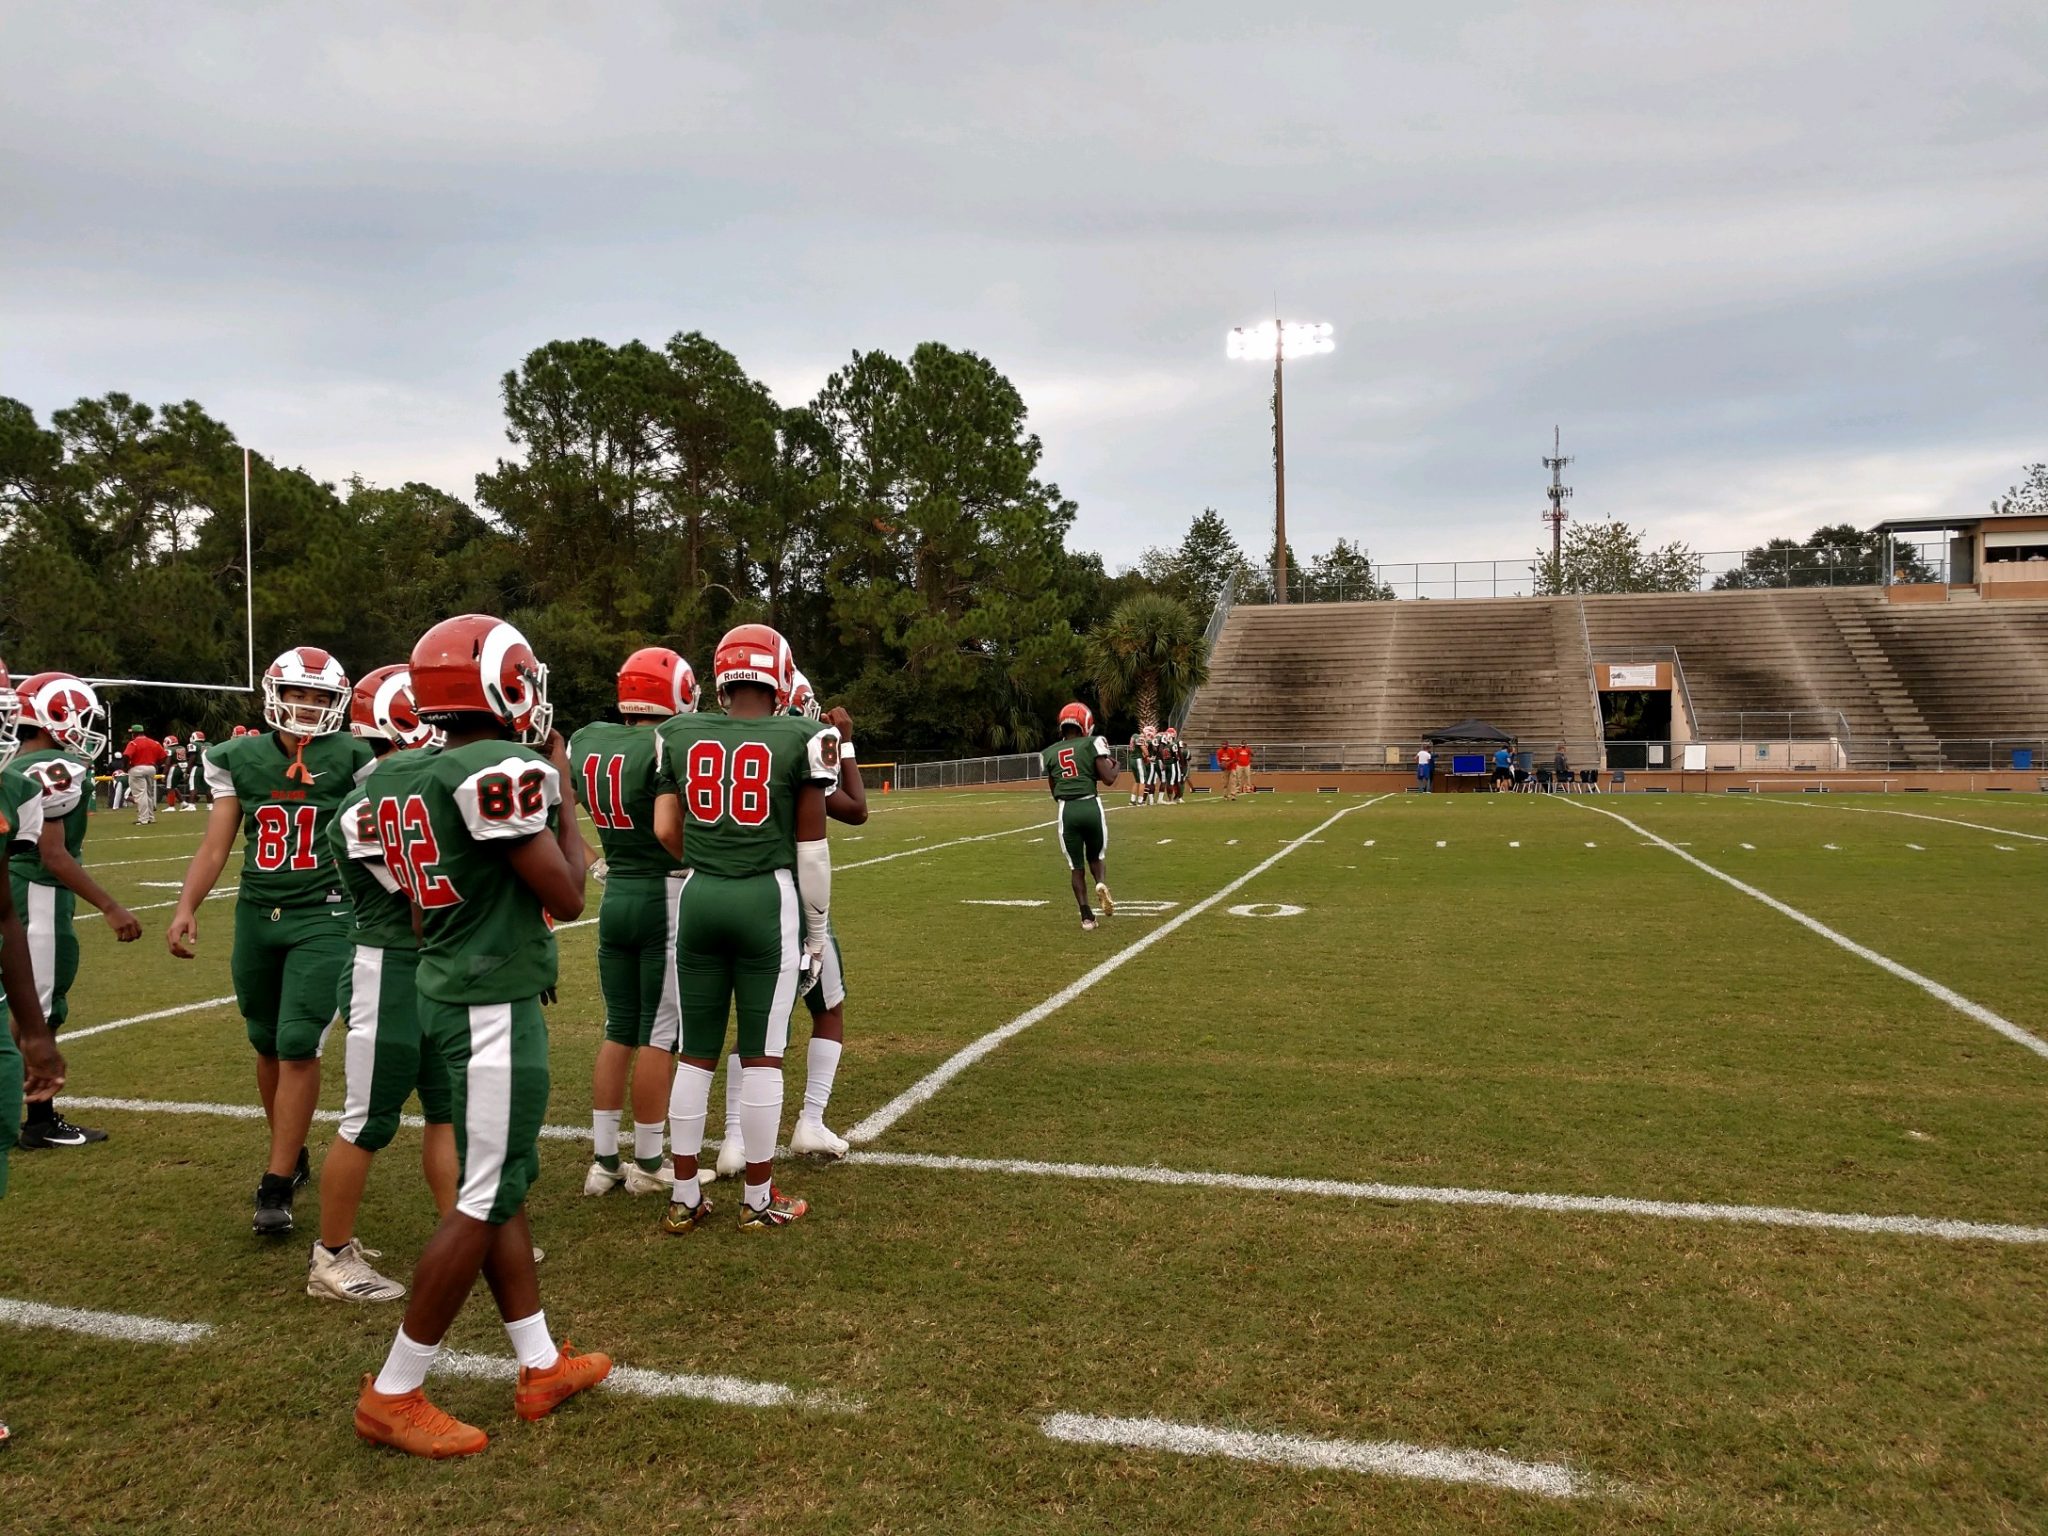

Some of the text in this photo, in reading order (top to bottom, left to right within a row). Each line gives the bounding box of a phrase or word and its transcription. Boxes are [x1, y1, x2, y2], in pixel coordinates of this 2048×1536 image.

[724, 671, 758, 681] Riddell
[476, 767, 546, 820] 82
[582, 753, 635, 830] 11
[685, 739, 773, 826] 88
[1057, 747, 1079, 779] 5
[254, 804, 318, 871] 81
[377, 794, 465, 909] 82
